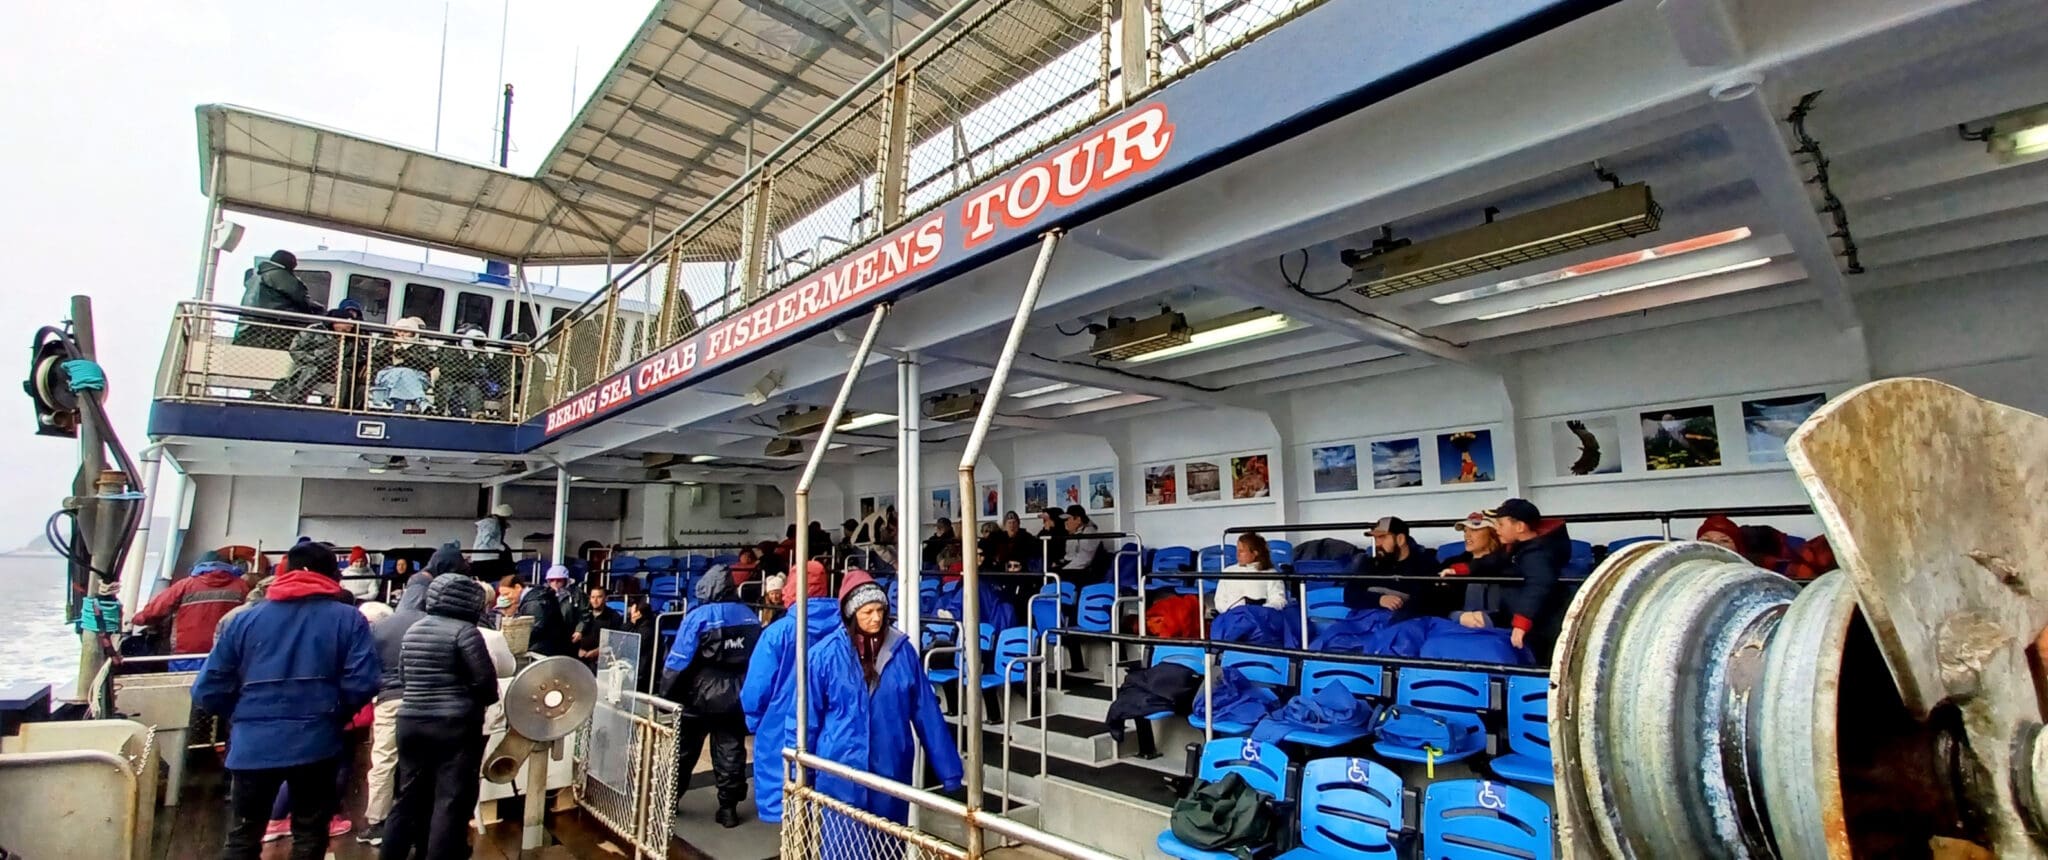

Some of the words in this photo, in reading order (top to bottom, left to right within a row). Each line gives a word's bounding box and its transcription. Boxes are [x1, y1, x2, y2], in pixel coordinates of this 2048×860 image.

[547, 391, 597, 433] BERING
[599, 375, 632, 408] SEA
[638, 342, 697, 390] CRAB
[706, 216, 943, 361] FISHERMENS
[967, 108, 1170, 240] TOUR
